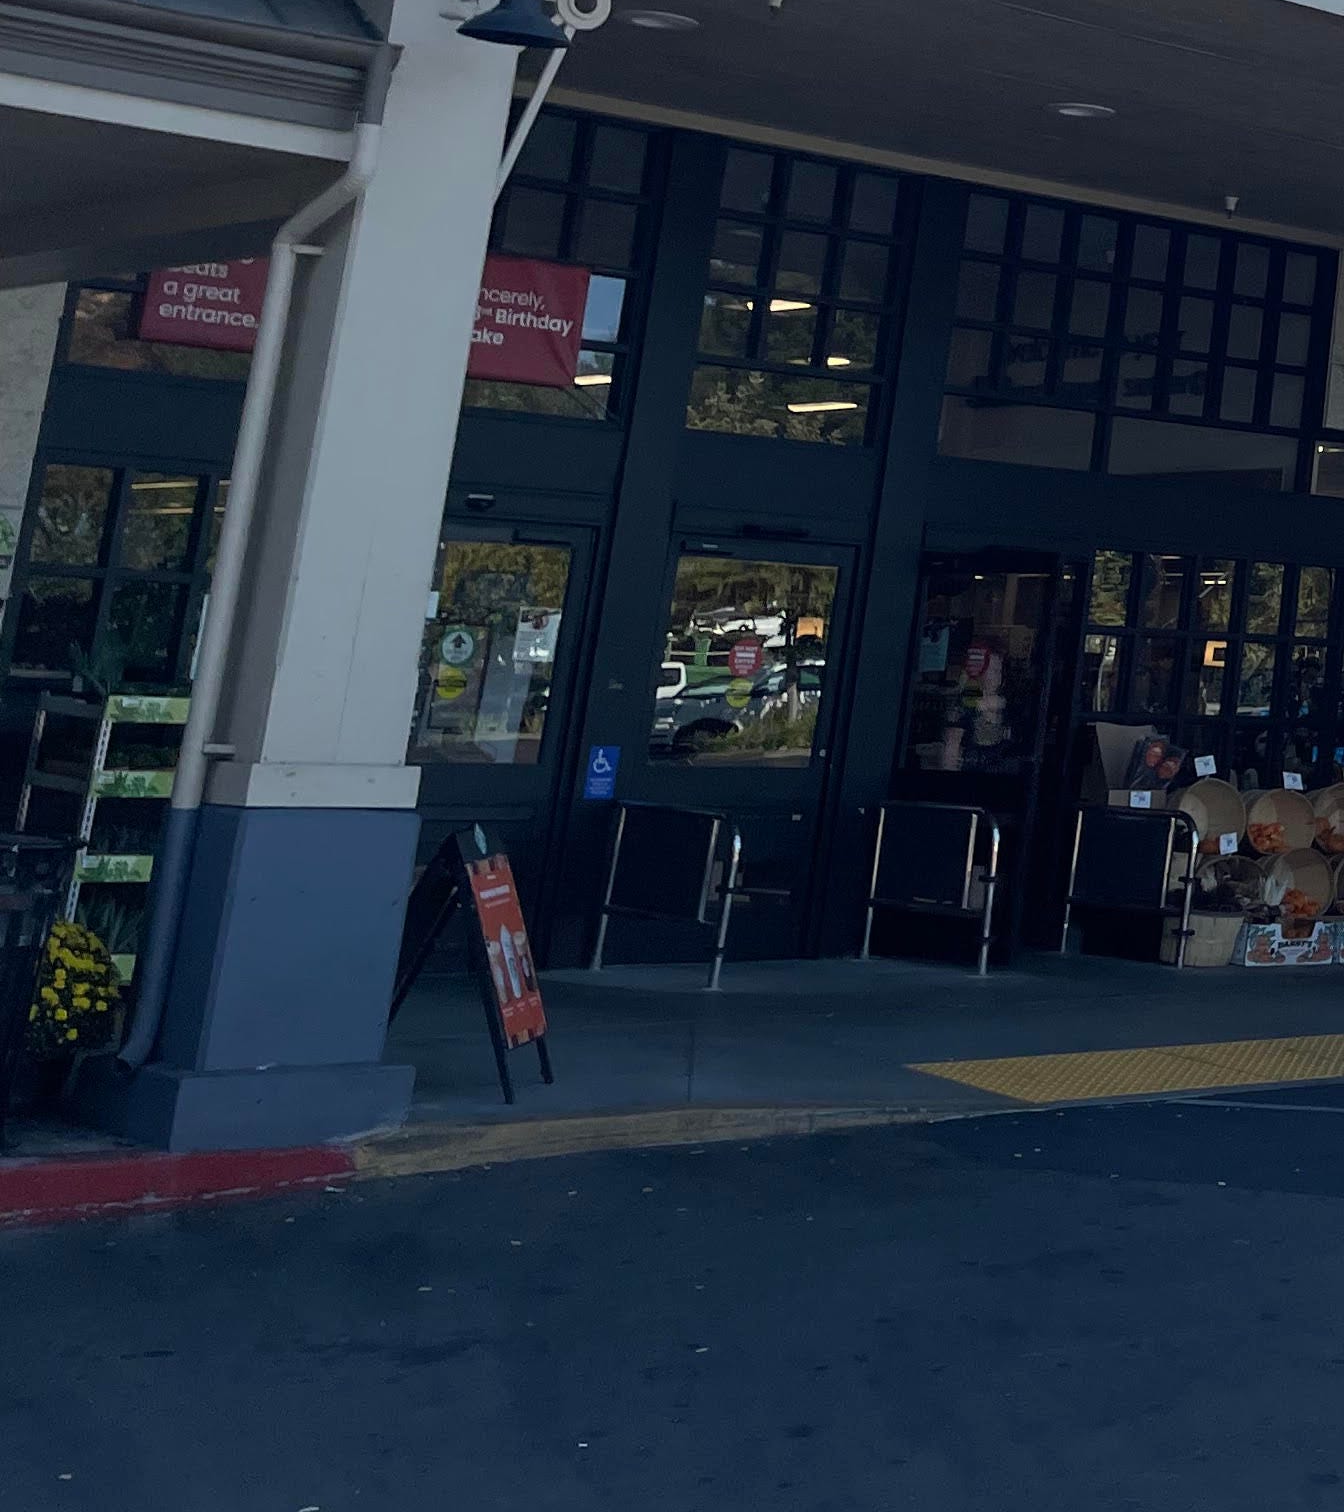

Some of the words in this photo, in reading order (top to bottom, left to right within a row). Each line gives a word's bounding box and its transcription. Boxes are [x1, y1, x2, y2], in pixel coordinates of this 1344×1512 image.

[163, 281, 178, 296] a
[183, 283, 241, 304] great
[480, 288, 545, 311] ncerely,
[159, 303, 259, 328] entrance.
[495, 308, 574, 337] Birthday
[471, 327, 504, 345] ake
